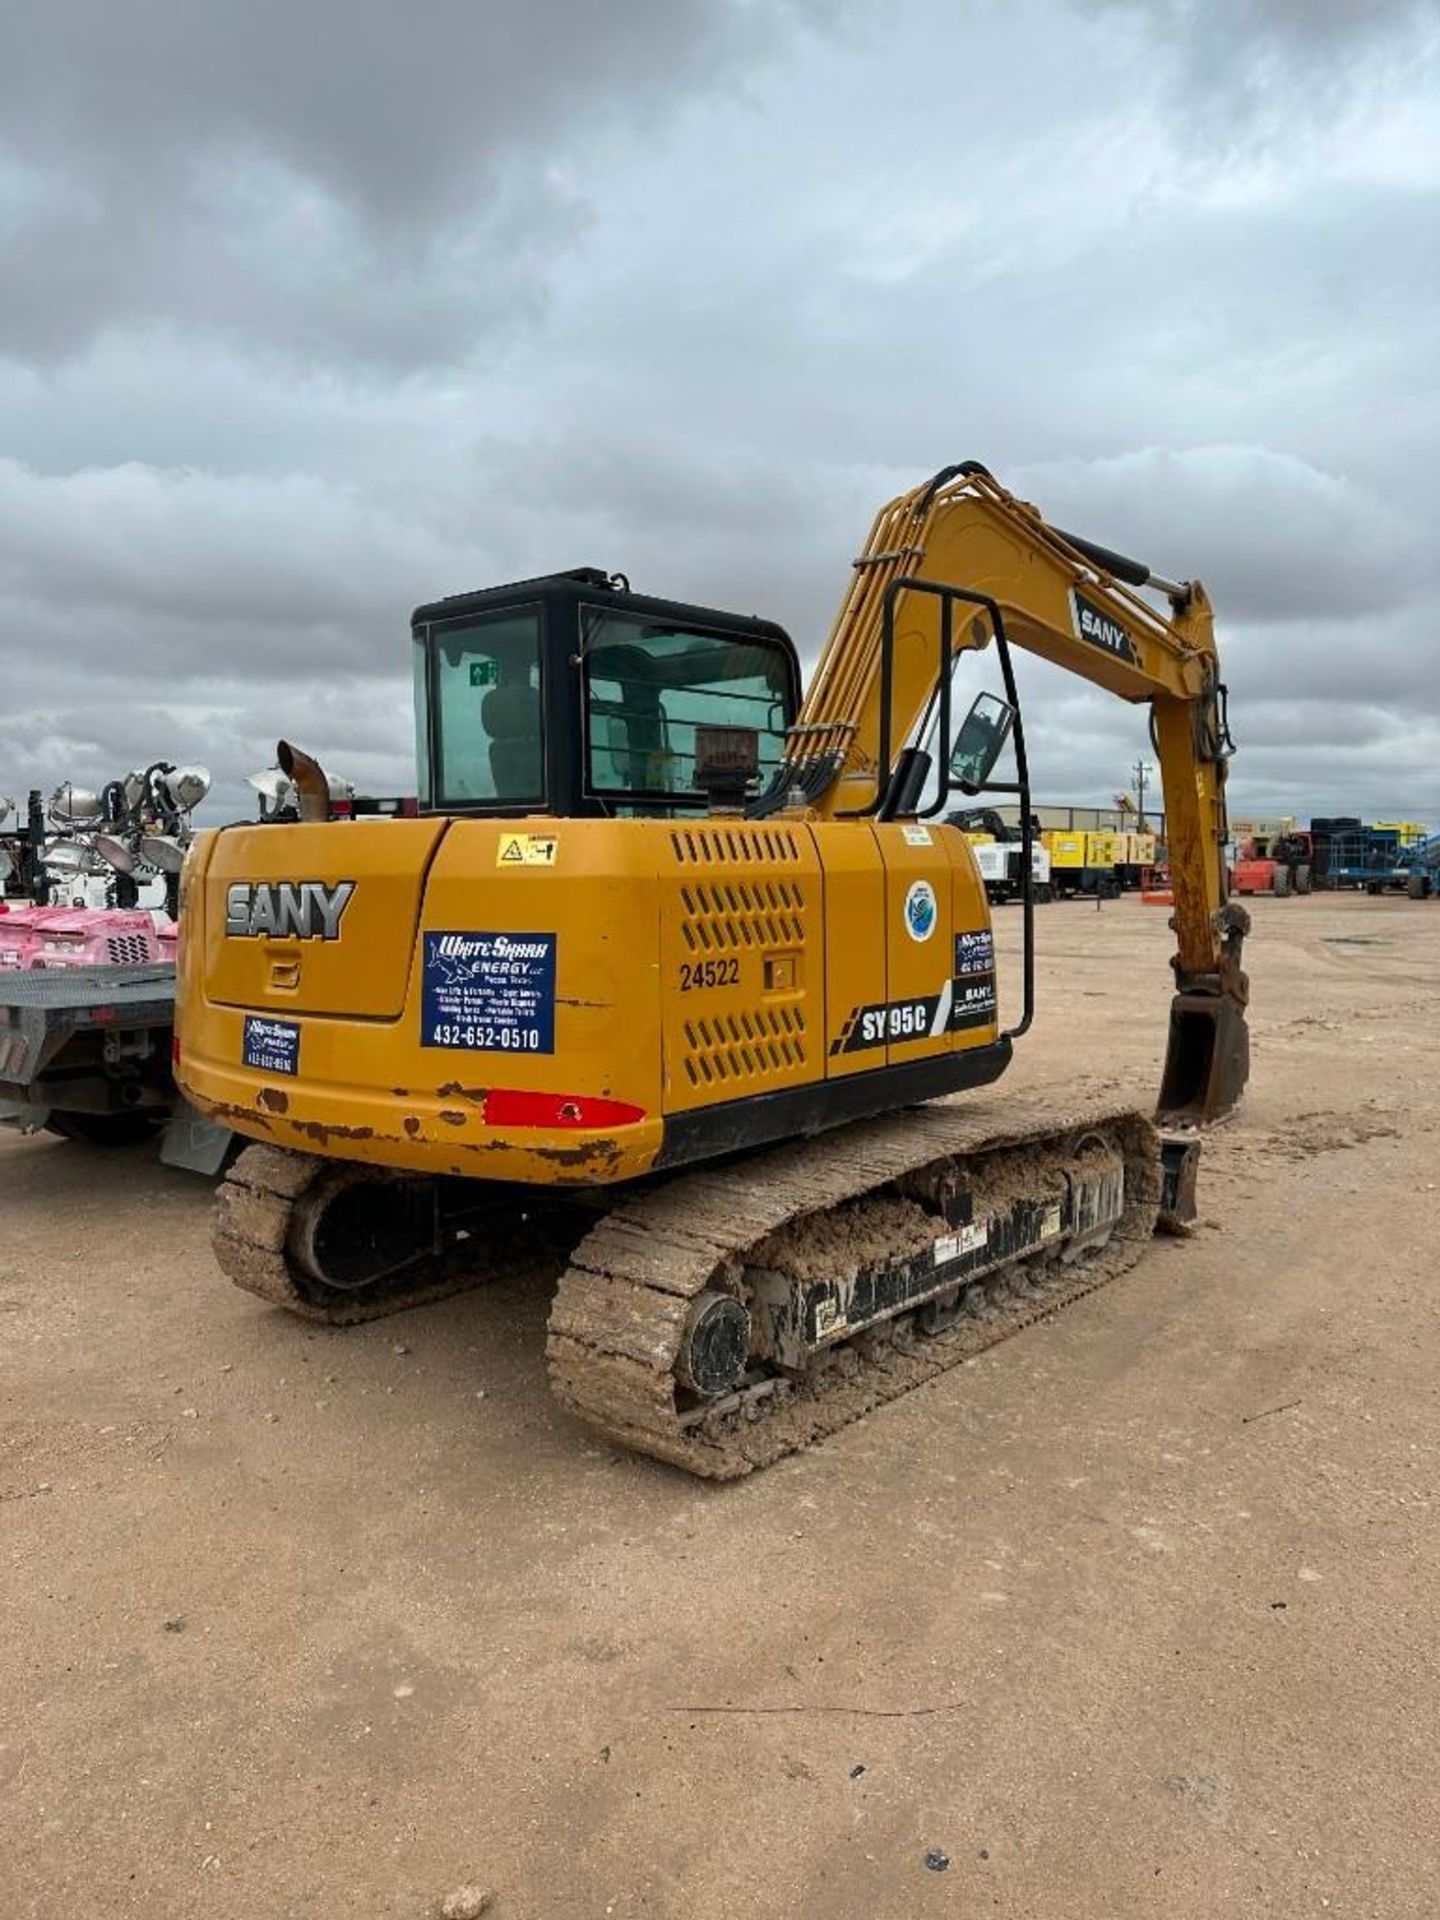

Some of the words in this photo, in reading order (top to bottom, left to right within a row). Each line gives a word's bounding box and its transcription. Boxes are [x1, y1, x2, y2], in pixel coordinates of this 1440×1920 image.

[1082, 609, 1124, 649] SANY
[226, 881, 356, 940] SANY
[471, 961, 531, 975] ENERGY
[680, 958, 739, 991] 24522
[433, 1024, 539, 1049] 432-652-0510
